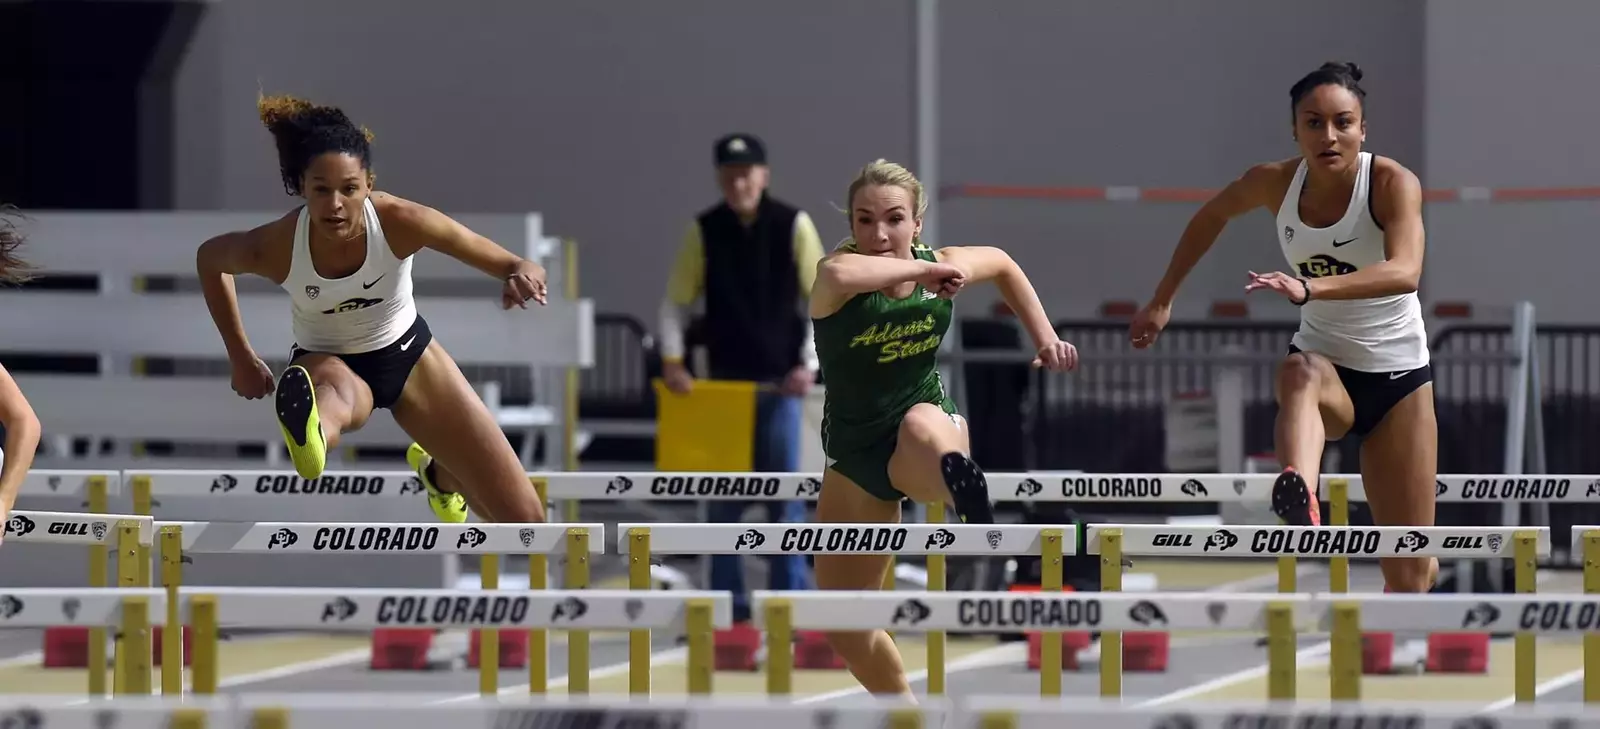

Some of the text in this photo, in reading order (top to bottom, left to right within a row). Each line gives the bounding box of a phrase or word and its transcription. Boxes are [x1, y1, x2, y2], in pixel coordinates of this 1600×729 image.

[849, 314, 936, 348] Adams
[254, 474, 386, 495] COLORADO
[650, 476, 781, 496] COLORADO
[1061, 477, 1162, 498] COLORADO
[1461, 479, 1571, 499] COLORADO
[47, 522, 89, 536] GILL
[312, 526, 440, 551] COLORADO
[780, 527, 909, 551] COLORADO
[1151, 533, 1193, 547] GILL
[1250, 529, 1382, 554] COLORADO
[1441, 536, 1483, 550] GILL
[375, 595, 531, 625] COLORADO
[957, 597, 1102, 627] COLORADO
[1518, 601, 1600, 631] COLO
